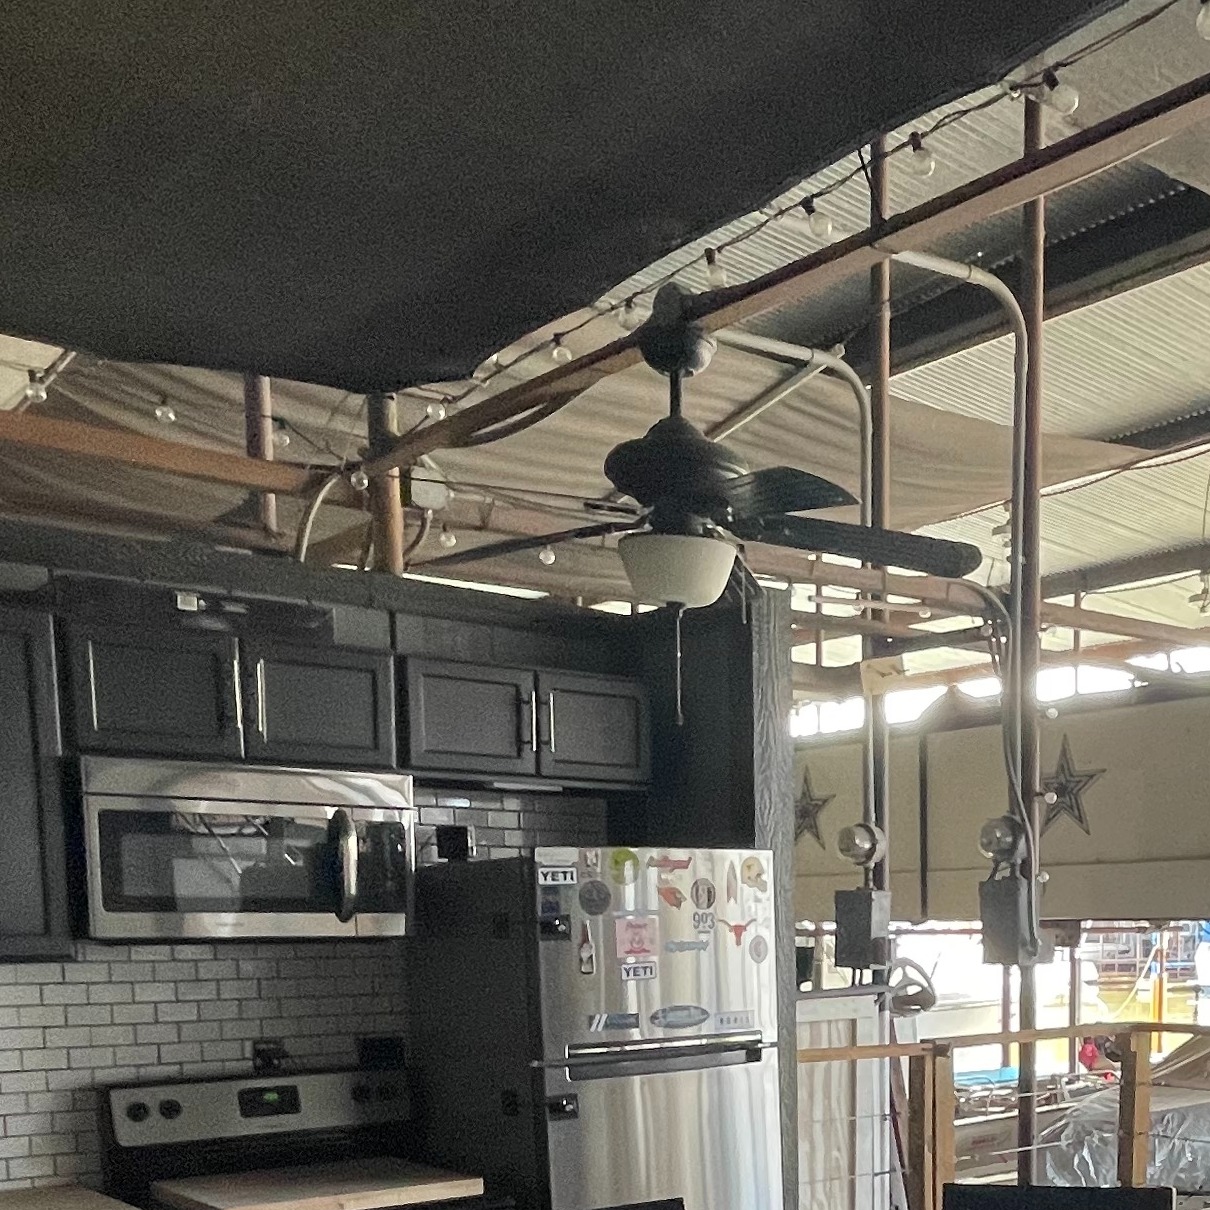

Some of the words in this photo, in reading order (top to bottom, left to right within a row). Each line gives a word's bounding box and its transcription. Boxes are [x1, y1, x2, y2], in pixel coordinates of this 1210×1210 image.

[541, 870, 575, 882] YETI
[693, 912, 715, 930] 903
[623, 965, 653, 977] YETI
